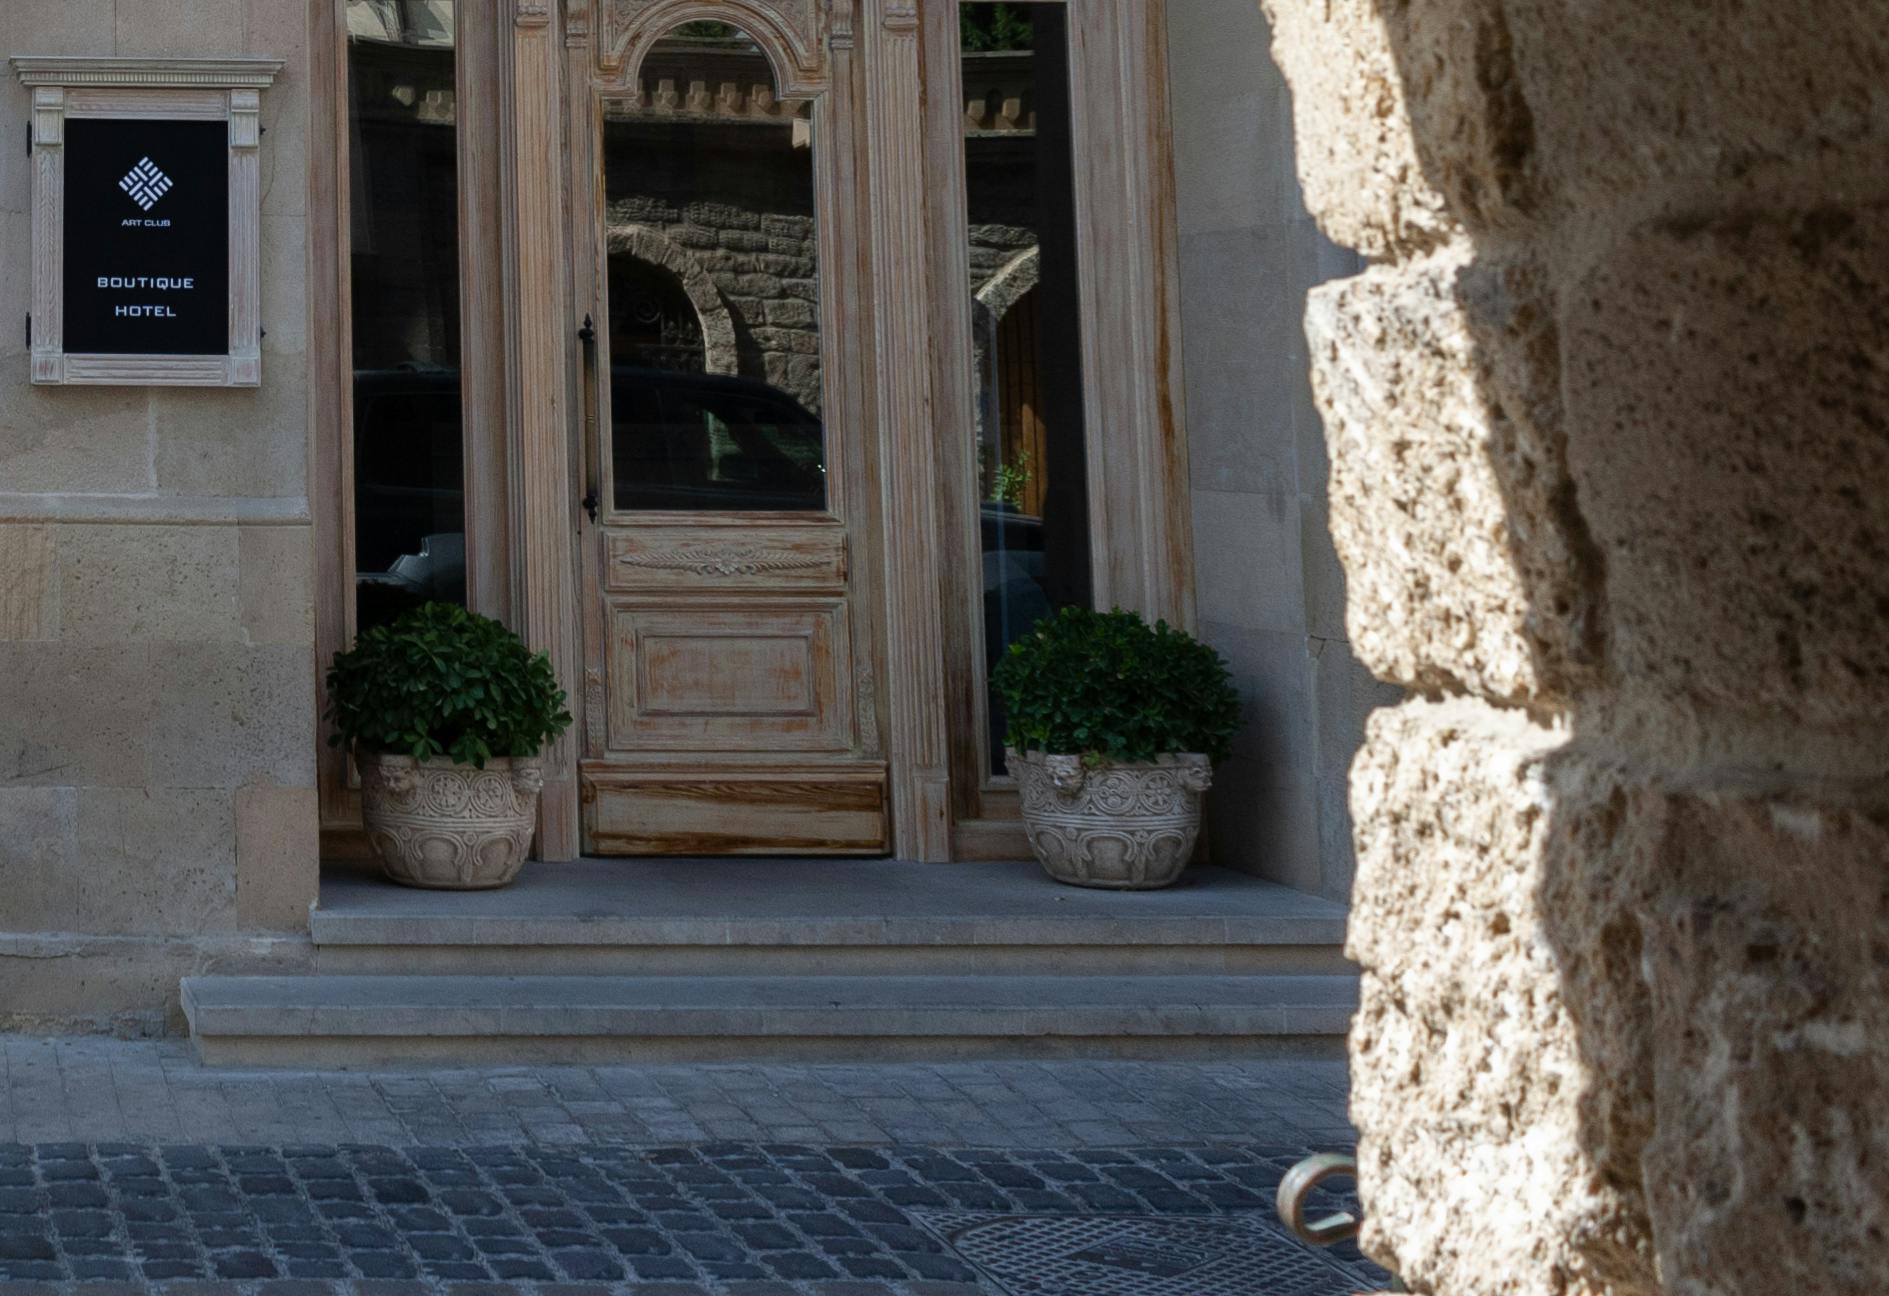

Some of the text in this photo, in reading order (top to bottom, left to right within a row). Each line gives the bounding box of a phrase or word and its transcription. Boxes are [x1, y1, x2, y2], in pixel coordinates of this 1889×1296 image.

[121, 218, 171, 227] ART CLUB
[97, 276, 194, 290] BOUTIQUE
[115, 305, 177, 317] HOTEL
